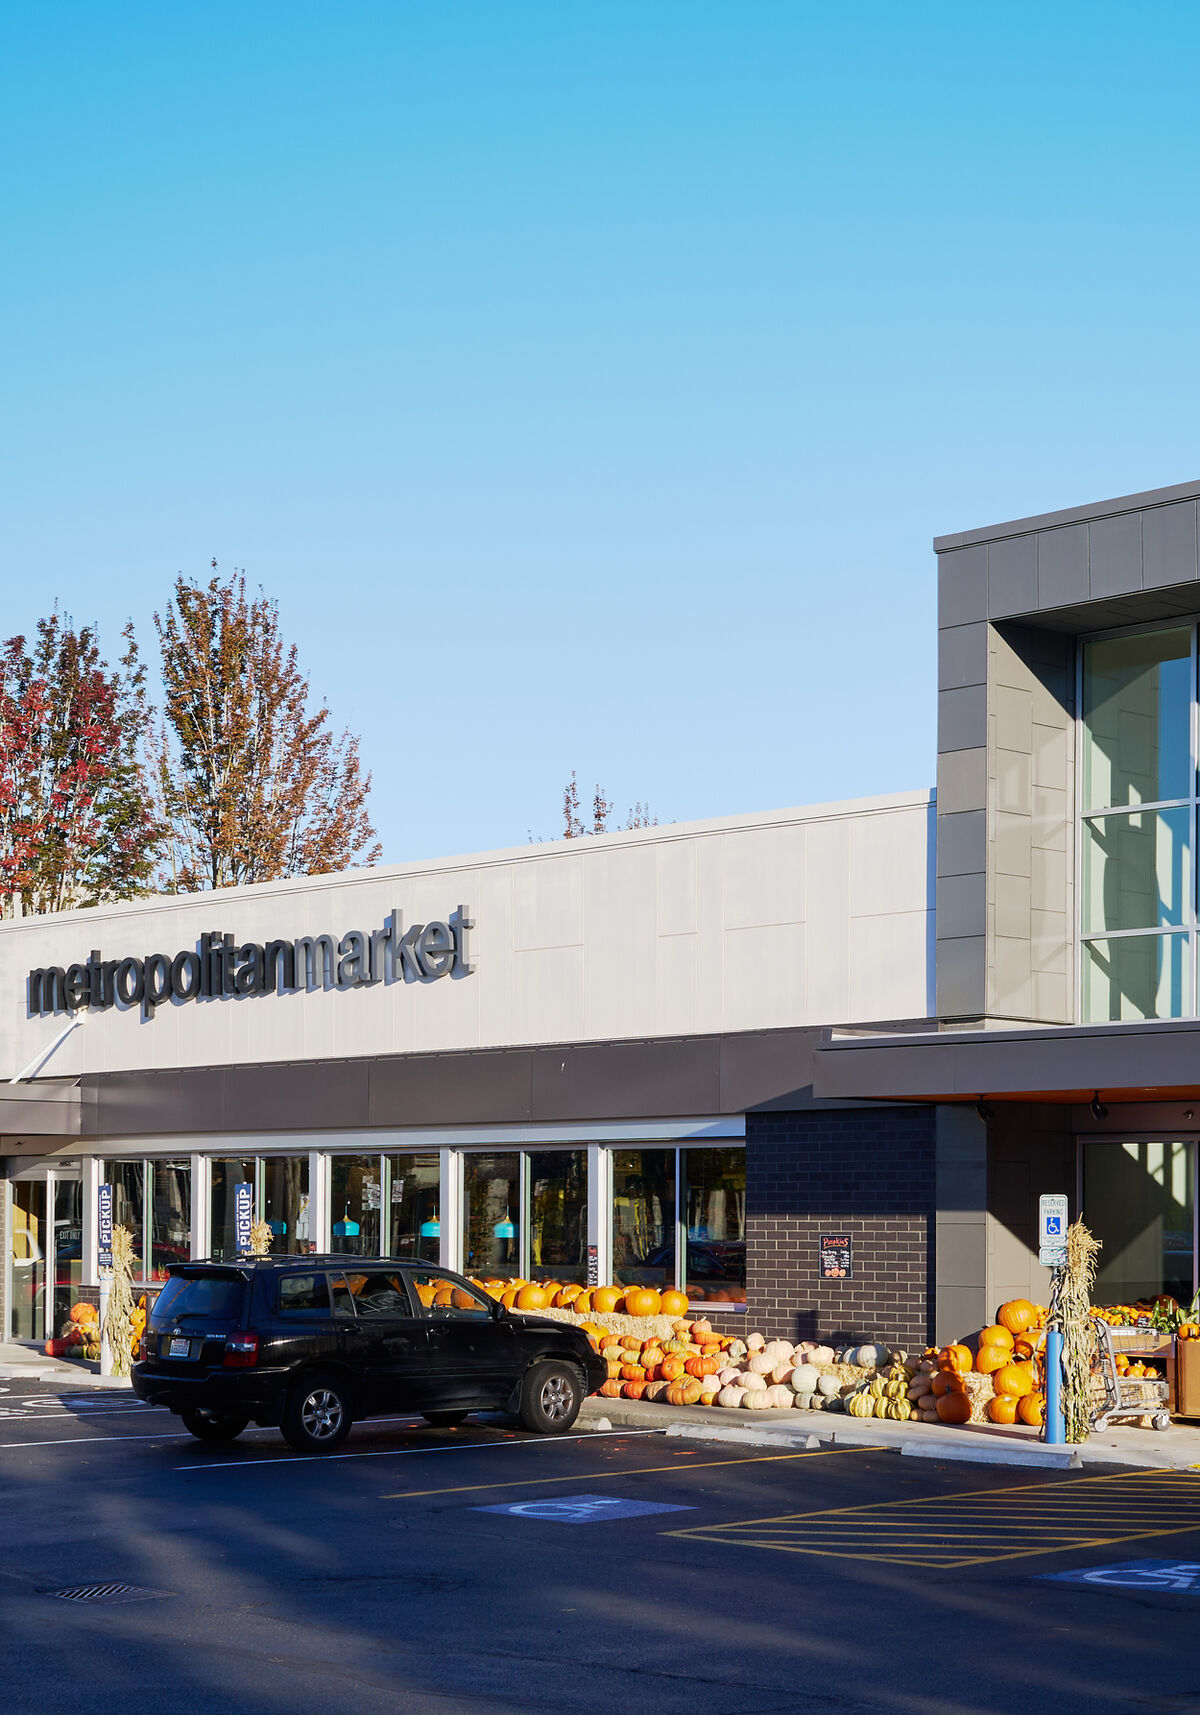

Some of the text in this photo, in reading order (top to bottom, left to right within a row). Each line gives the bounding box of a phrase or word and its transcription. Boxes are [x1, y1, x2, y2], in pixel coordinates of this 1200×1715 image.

[101, 1189, 111, 1244] PICKUP
[239, 1188, 250, 1246] PICKUP
[1041, 1199, 1065, 1207] RESERVED
[1043, 1208, 1063, 1216] PARKING
